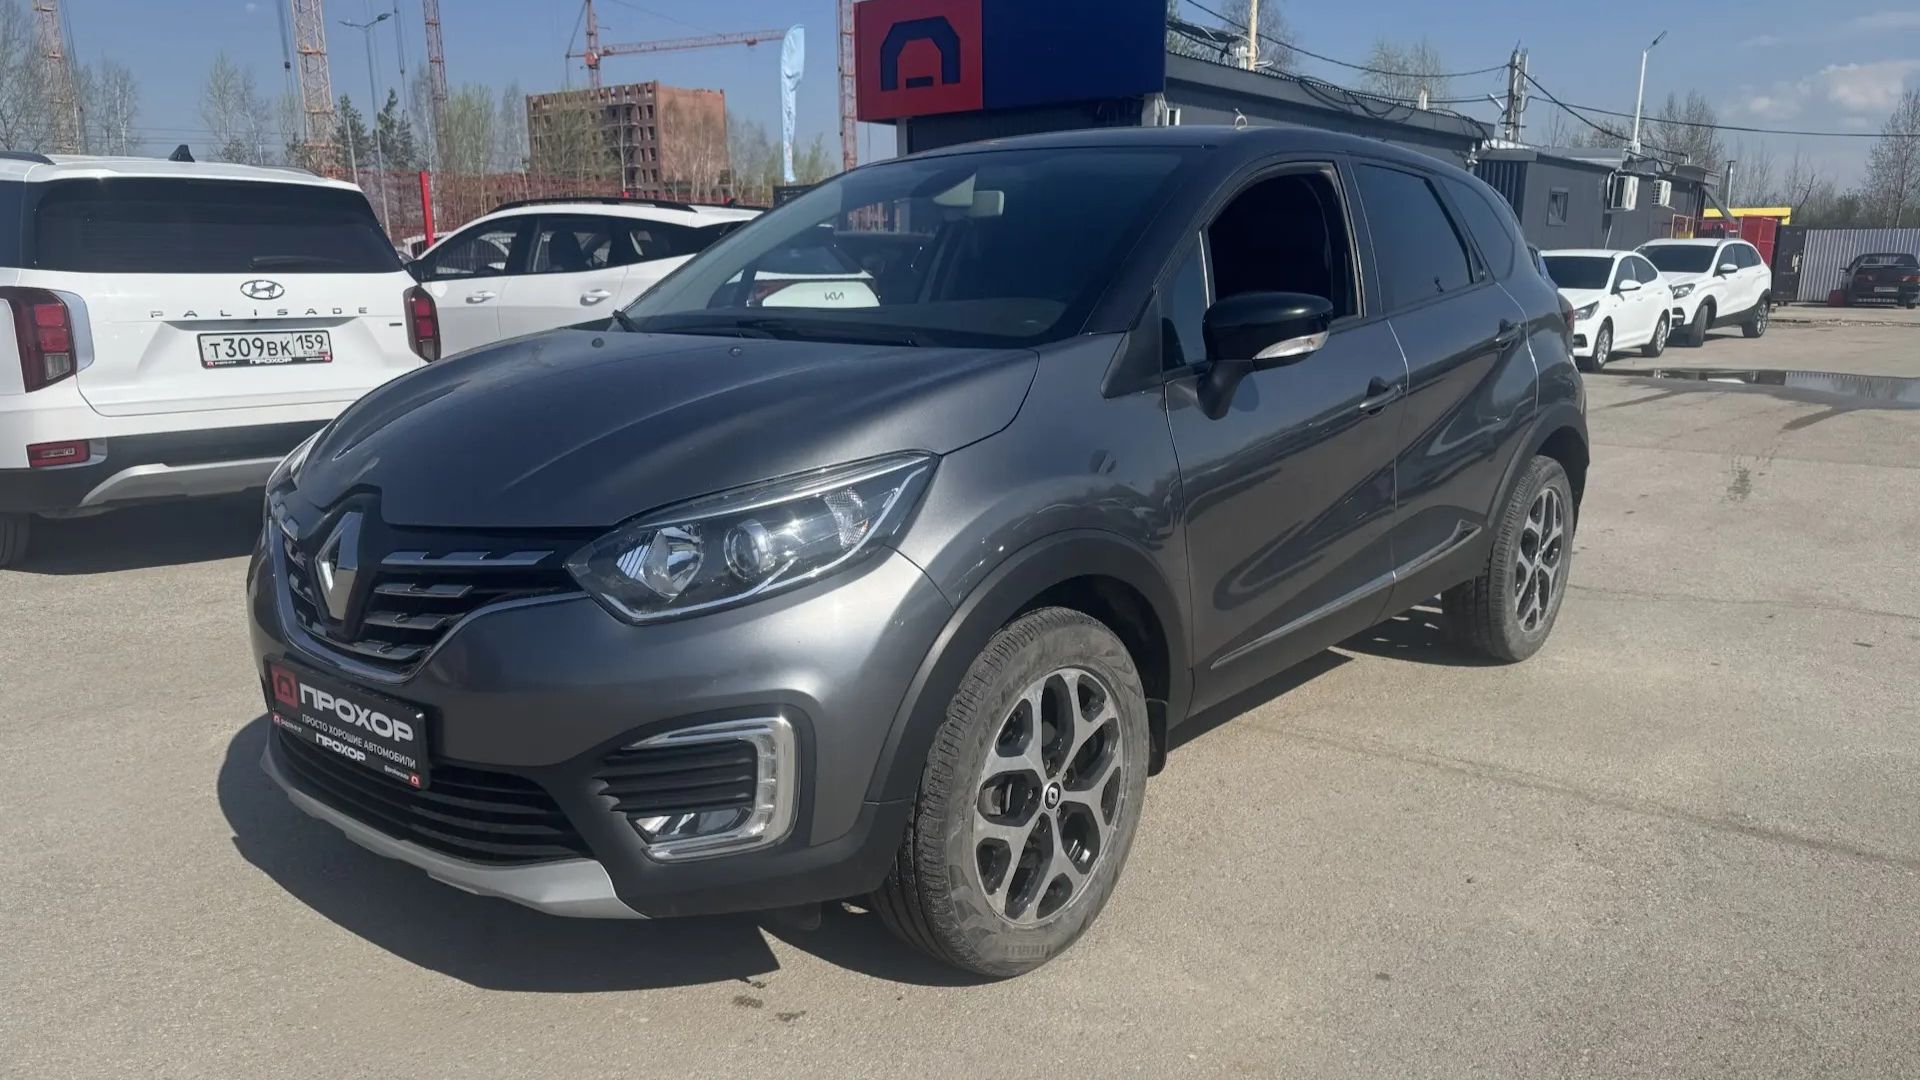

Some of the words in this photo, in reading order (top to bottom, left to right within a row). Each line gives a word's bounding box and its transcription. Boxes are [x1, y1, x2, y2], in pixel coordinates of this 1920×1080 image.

[150, 307, 368, 318] PALISADE
[295, 334, 324, 351] 159
[299, 682, 414, 743] ПРОХОР
[302, 713, 328, 732] ПРОСТО
[328, 724, 363, 748] ХОРОШИЕ
[363, 739, 416, 769] АВТОМОБИЛИ
[315, 732, 366, 762] ПРОХОР
